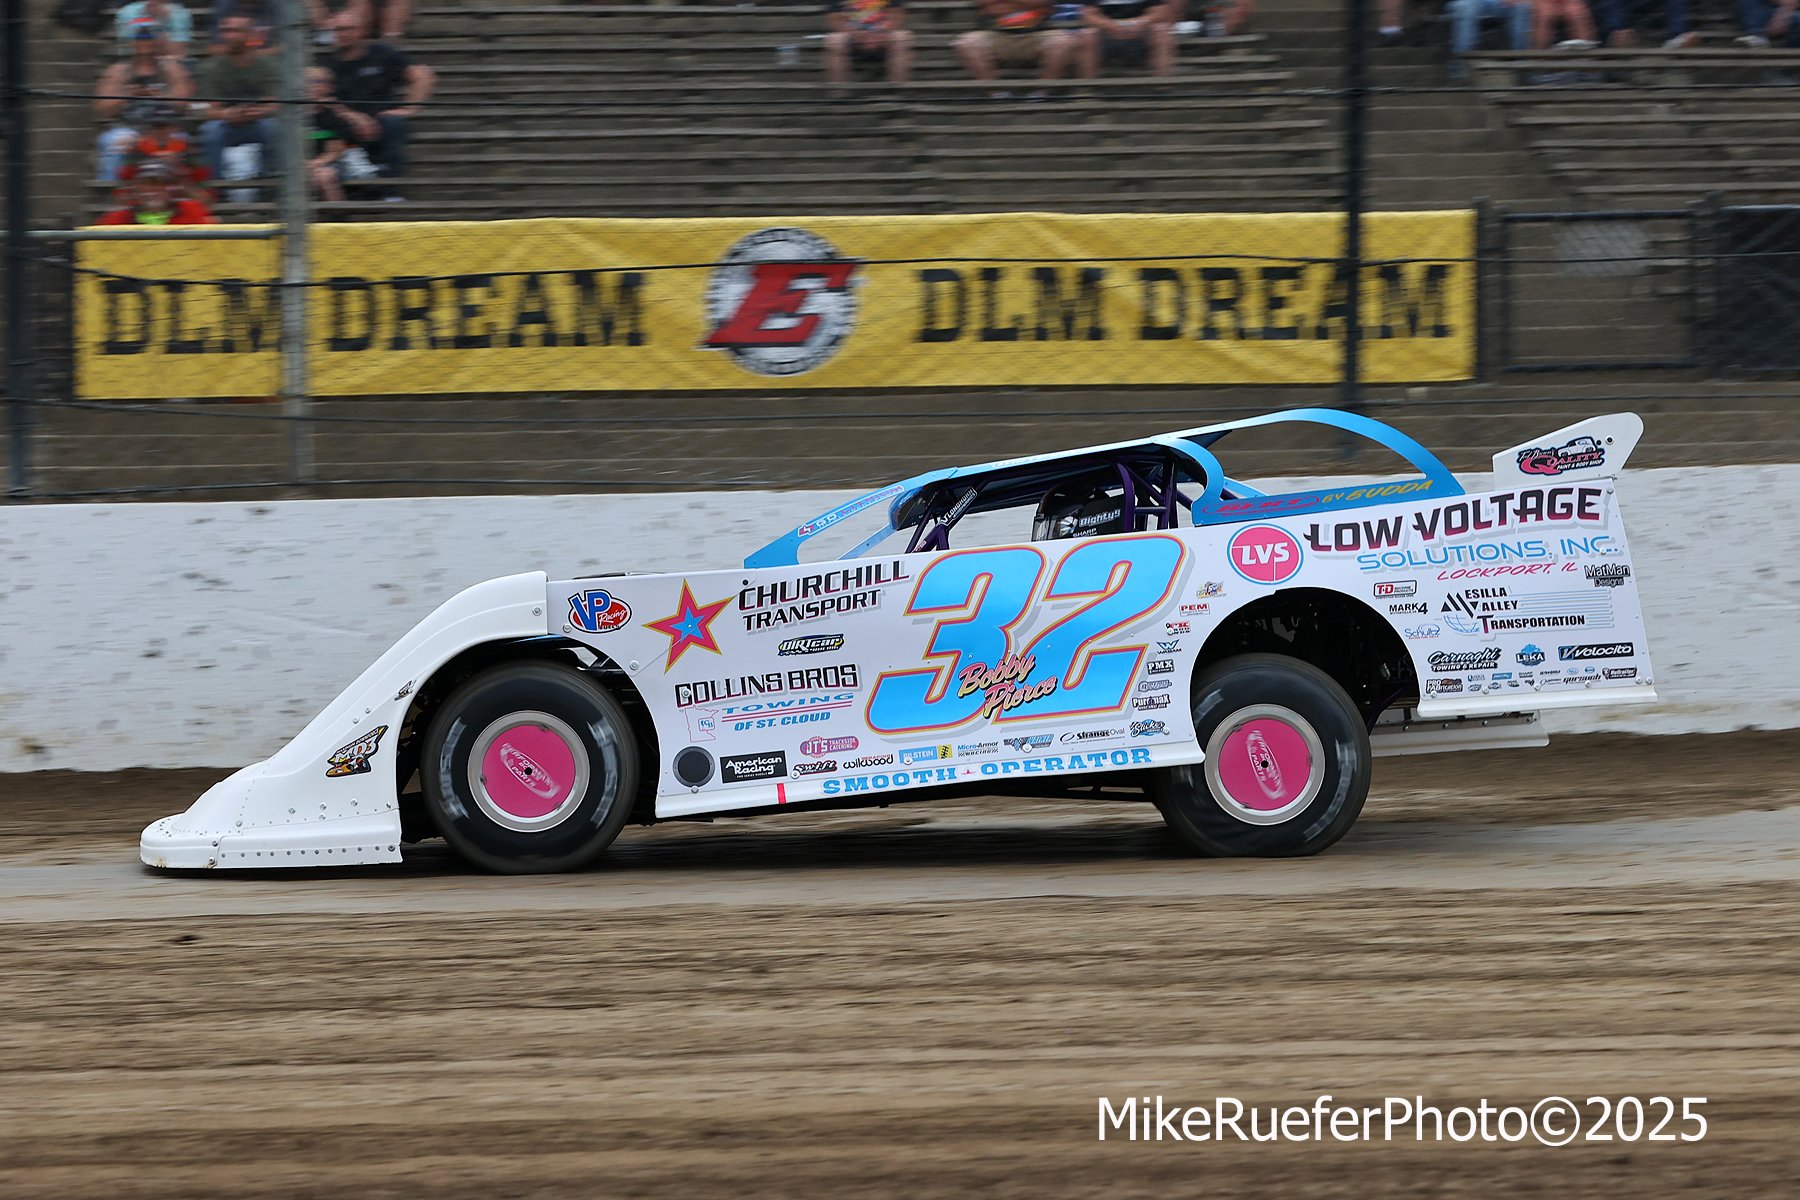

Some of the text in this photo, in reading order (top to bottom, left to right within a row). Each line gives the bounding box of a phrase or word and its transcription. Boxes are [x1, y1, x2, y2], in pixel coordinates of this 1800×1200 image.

[324, 270, 649, 351] DREAM
[917, 264, 1452, 341] DLM DREAM
[1303, 488, 1602, 553] LOW VOLTAGE
[1238, 541, 1291, 565] LVS
[1559, 536, 1619, 555] INC.
[738, 561, 910, 611] CHURCHILL
[1561, 562, 1579, 572] IL
[1584, 564, 1631, 577] MatMan
[570, 591, 612, 631] VP
[743, 589, 880, 631] TRANSPORT
[1477, 615, 1586, 634] TRANSPORTATION
[865, 533, 1186, 735] 32
[958, 655, 1036, 697] Bobby
[1148, 660, 1173, 670] PMX
[675, 664, 858, 708] COLLINS BROS
[722, 693, 854, 714] TOWING
[983, 676, 1058, 718] Pierce
[734, 712, 831, 731] OF ST. CLOUD
[725, 756, 783, 769] American
[734, 764, 775, 777] Racing
[823, 748, 1152, 795] SMOOTH OPERATOR
